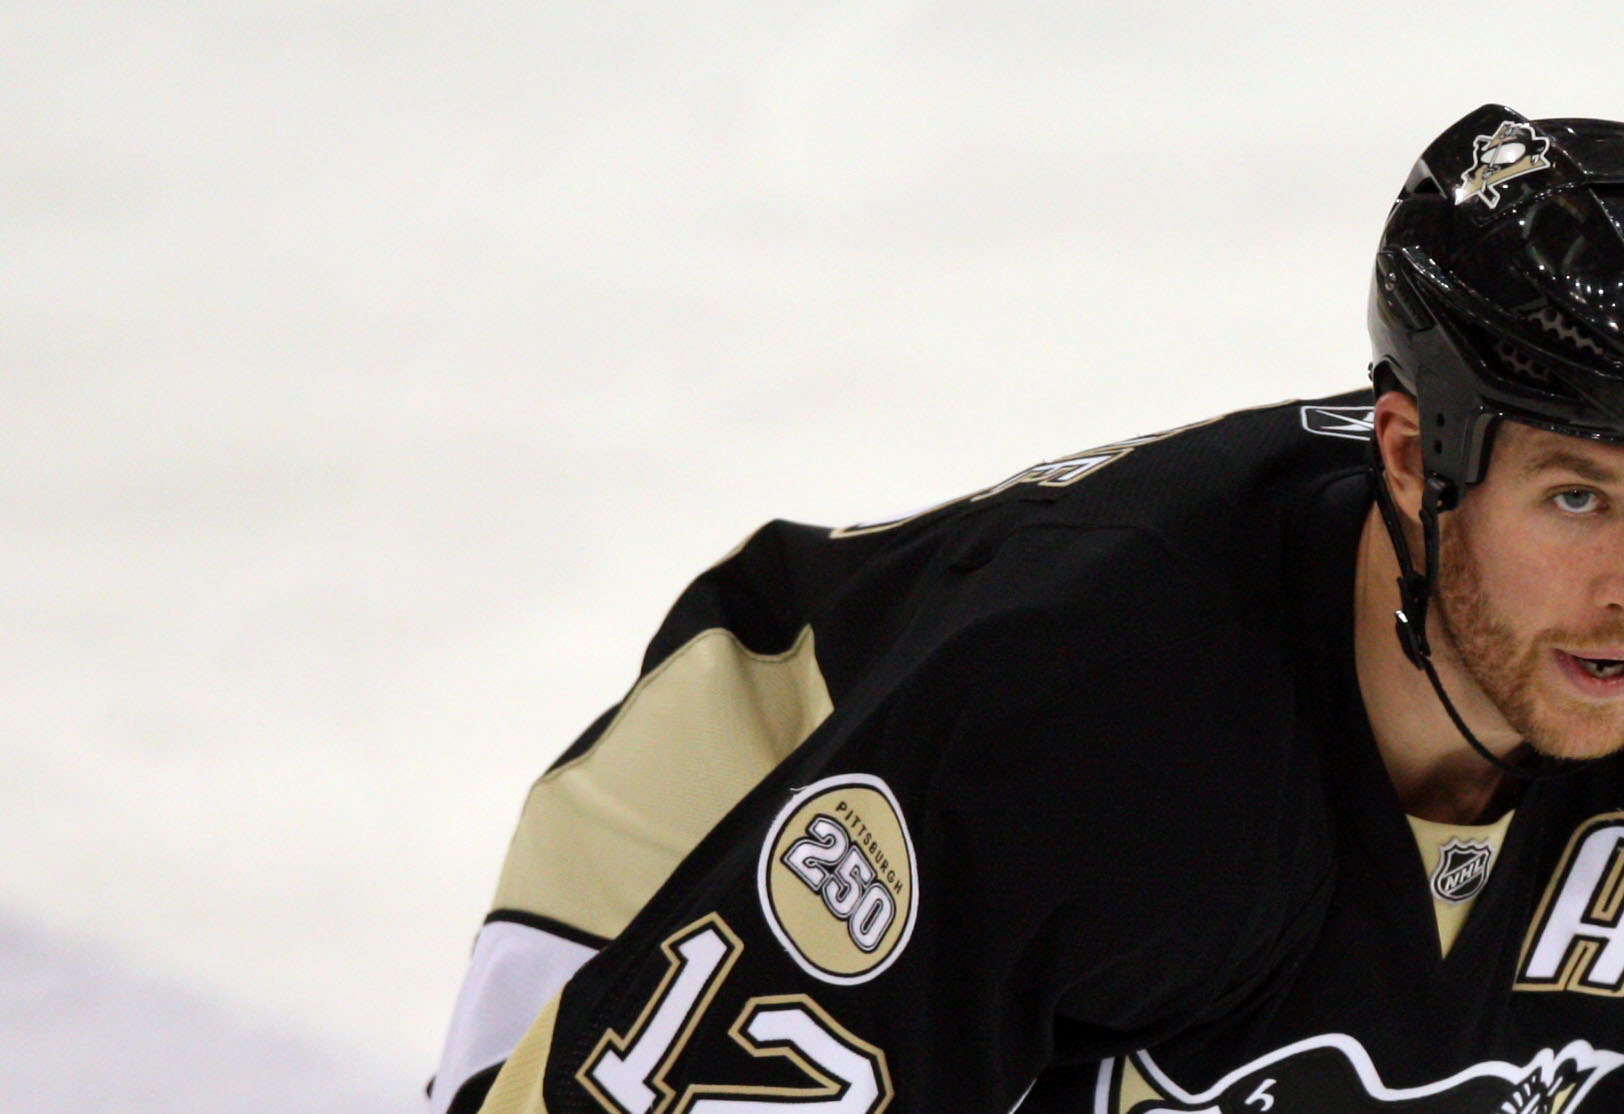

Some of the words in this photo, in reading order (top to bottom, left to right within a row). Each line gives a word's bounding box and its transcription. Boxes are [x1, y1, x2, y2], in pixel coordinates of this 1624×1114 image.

[780, 813, 896, 954] 250
[835, 801, 904, 894] PITTSBURGH
[1444, 858, 1486, 892] NHL
